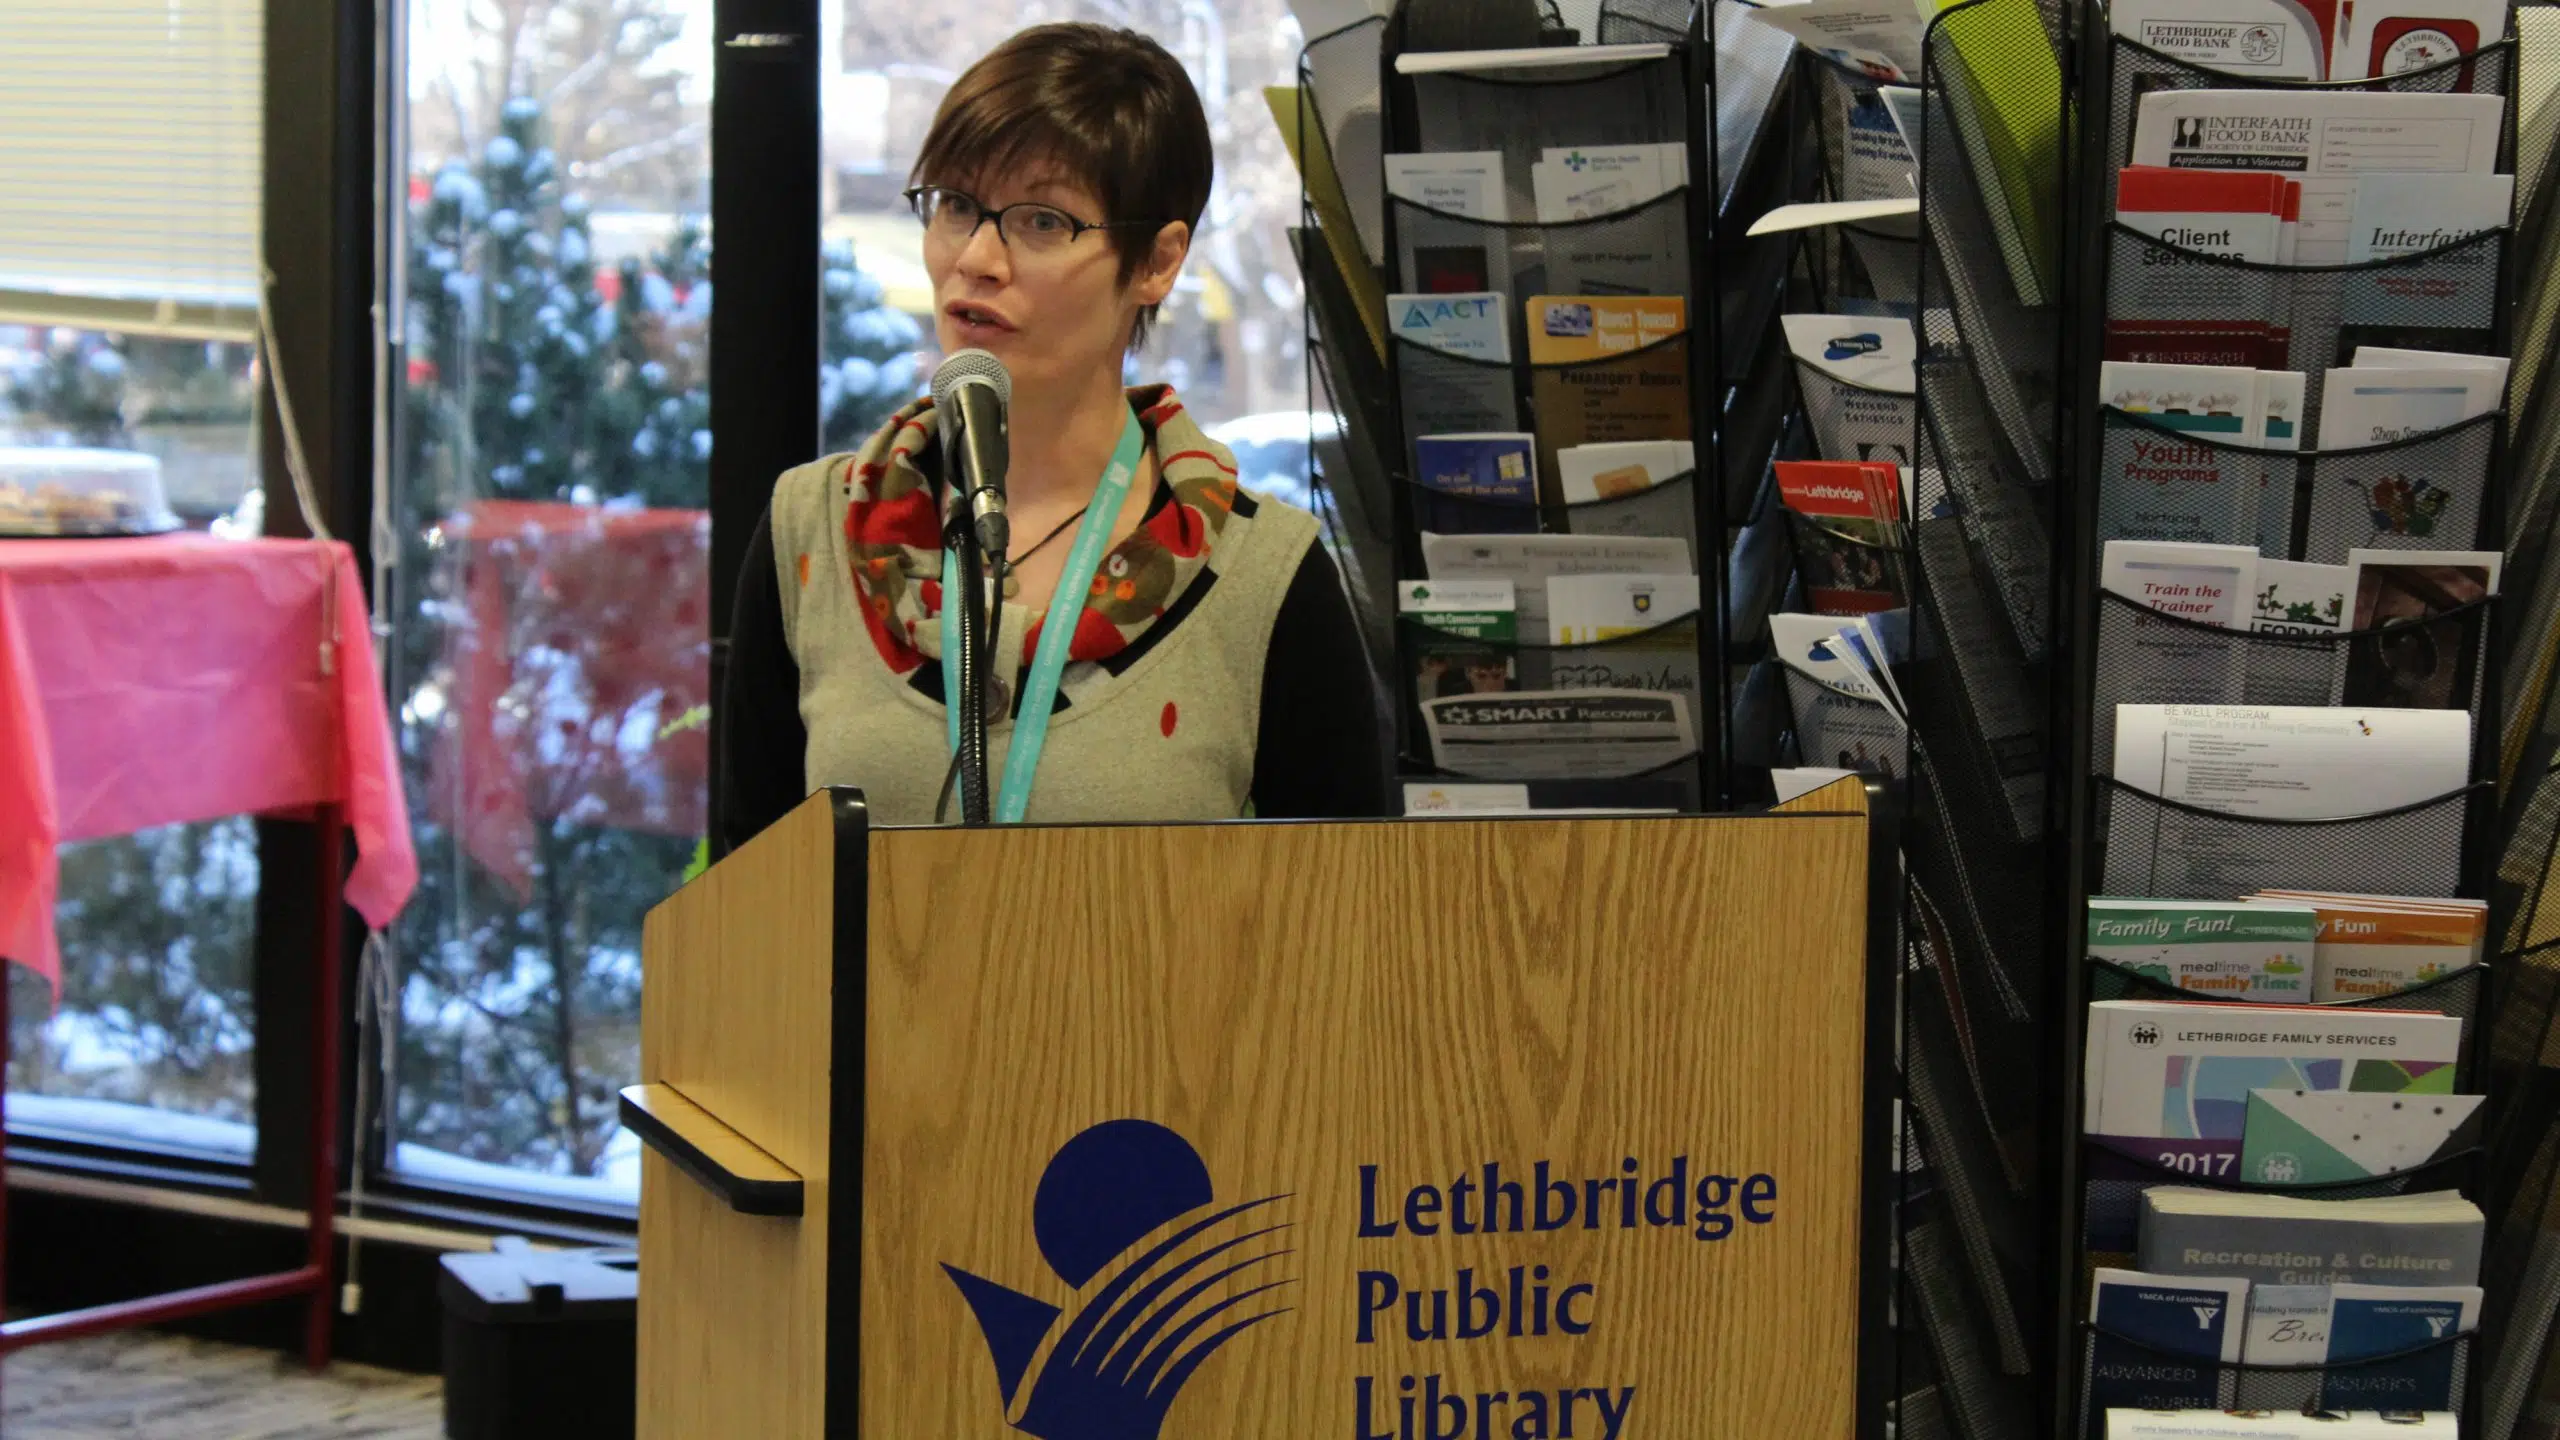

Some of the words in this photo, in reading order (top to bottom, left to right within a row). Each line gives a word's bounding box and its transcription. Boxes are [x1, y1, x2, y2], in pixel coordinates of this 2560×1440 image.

[2147, 26, 2238, 38] LETHBRIDGE
[2152, 36, 2189, 47] FOOD
[2193, 37, 2231, 49] BANK
[2208, 116, 2313, 130] INTERFAITH
[2207, 129, 2257, 142] FOOD
[2261, 130, 2311, 144] BANK
[2173, 156, 2233, 168] Application
[2236, 156, 2249, 165] to
[2252, 157, 2303, 168] Volunteer
[2160, 228, 2231, 246] Client
[1433, 299, 1489, 321] ACT
[2132, 439, 2214, 465] Youth
[2124, 462, 2220, 485] Programs
[1803, 484, 1864, 504] Lethbridge
[2144, 582, 2190, 596] Train
[2195, 584, 2222, 598] the
[2150, 599, 2214, 614] Trainer
[1476, 706, 1571, 723] SMART
[1577, 708, 1665, 723] Recovery
[2164, 706, 2181, 717] BE
[2183, 707, 2213, 718] WELL
[2215, 708, 2270, 721] PROGRAM
[2096, 917, 2173, 939] Family
[2183, 915, 2236, 934] Fun!
[2180, 960, 2252, 974] mealtime
[2334, 966, 2404, 980] mealtime
[2177, 1031, 2269, 1044] LETHBRIDGE
[2271, 1033, 2323, 1045] FAMILY
[2325, 1034, 2398, 1047] SERVICES
[2158, 1152, 2236, 1176] 2017
[1357, 1155, 1777, 1241] Lethbridge
[2183, 1249, 2323, 1269] Recreation
[2331, 1253, 2349, 1268] &
[2358, 1253, 2453, 1272] Culture
[2279, 1270, 2353, 1286] Guide
[1355, 1264, 1594, 1344] Public
[2096, 1364, 2197, 1381] ADVANCED
[2326, 1374, 2417, 1392] AQUATICS
[1355, 1373, 1637, 1440] Library
